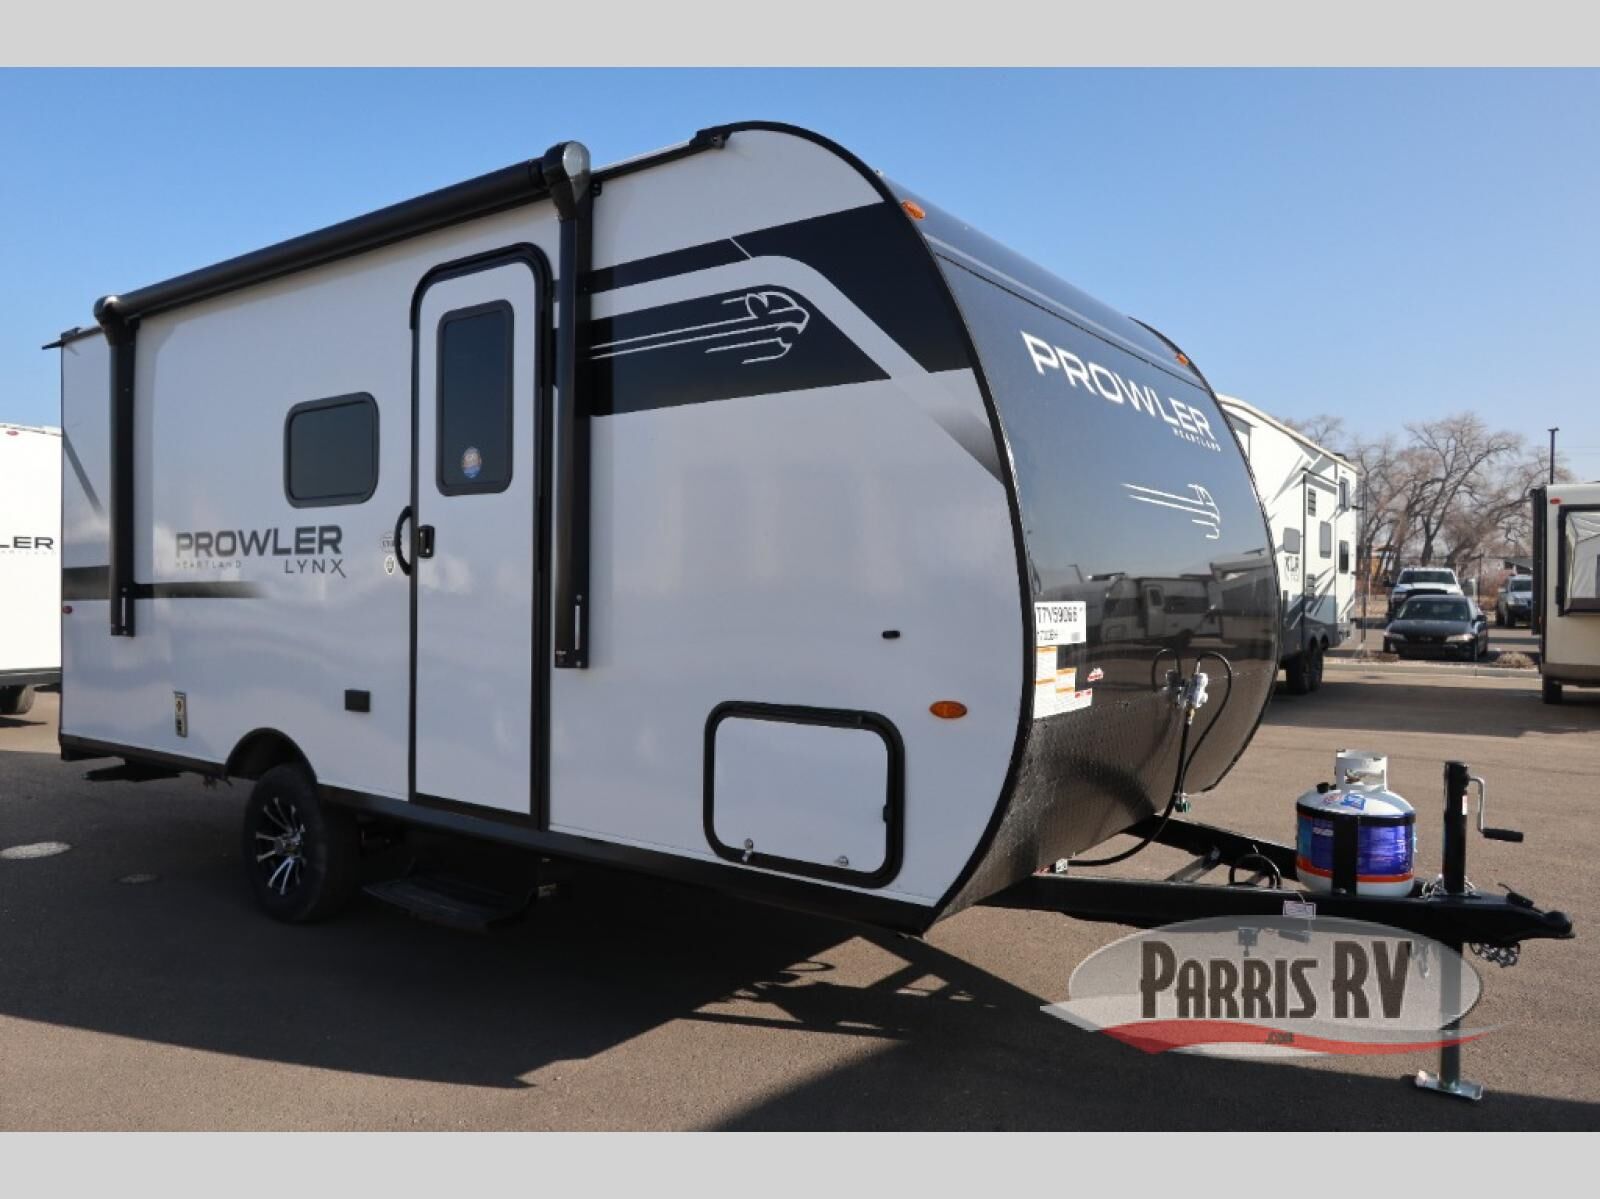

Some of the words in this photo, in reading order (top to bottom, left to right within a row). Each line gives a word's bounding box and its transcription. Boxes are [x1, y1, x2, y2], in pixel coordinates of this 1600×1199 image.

[1020, 330, 1217, 441] PROWLER
[176, 525, 343, 558] PROWLER
[285, 558, 347, 579] LYNX
